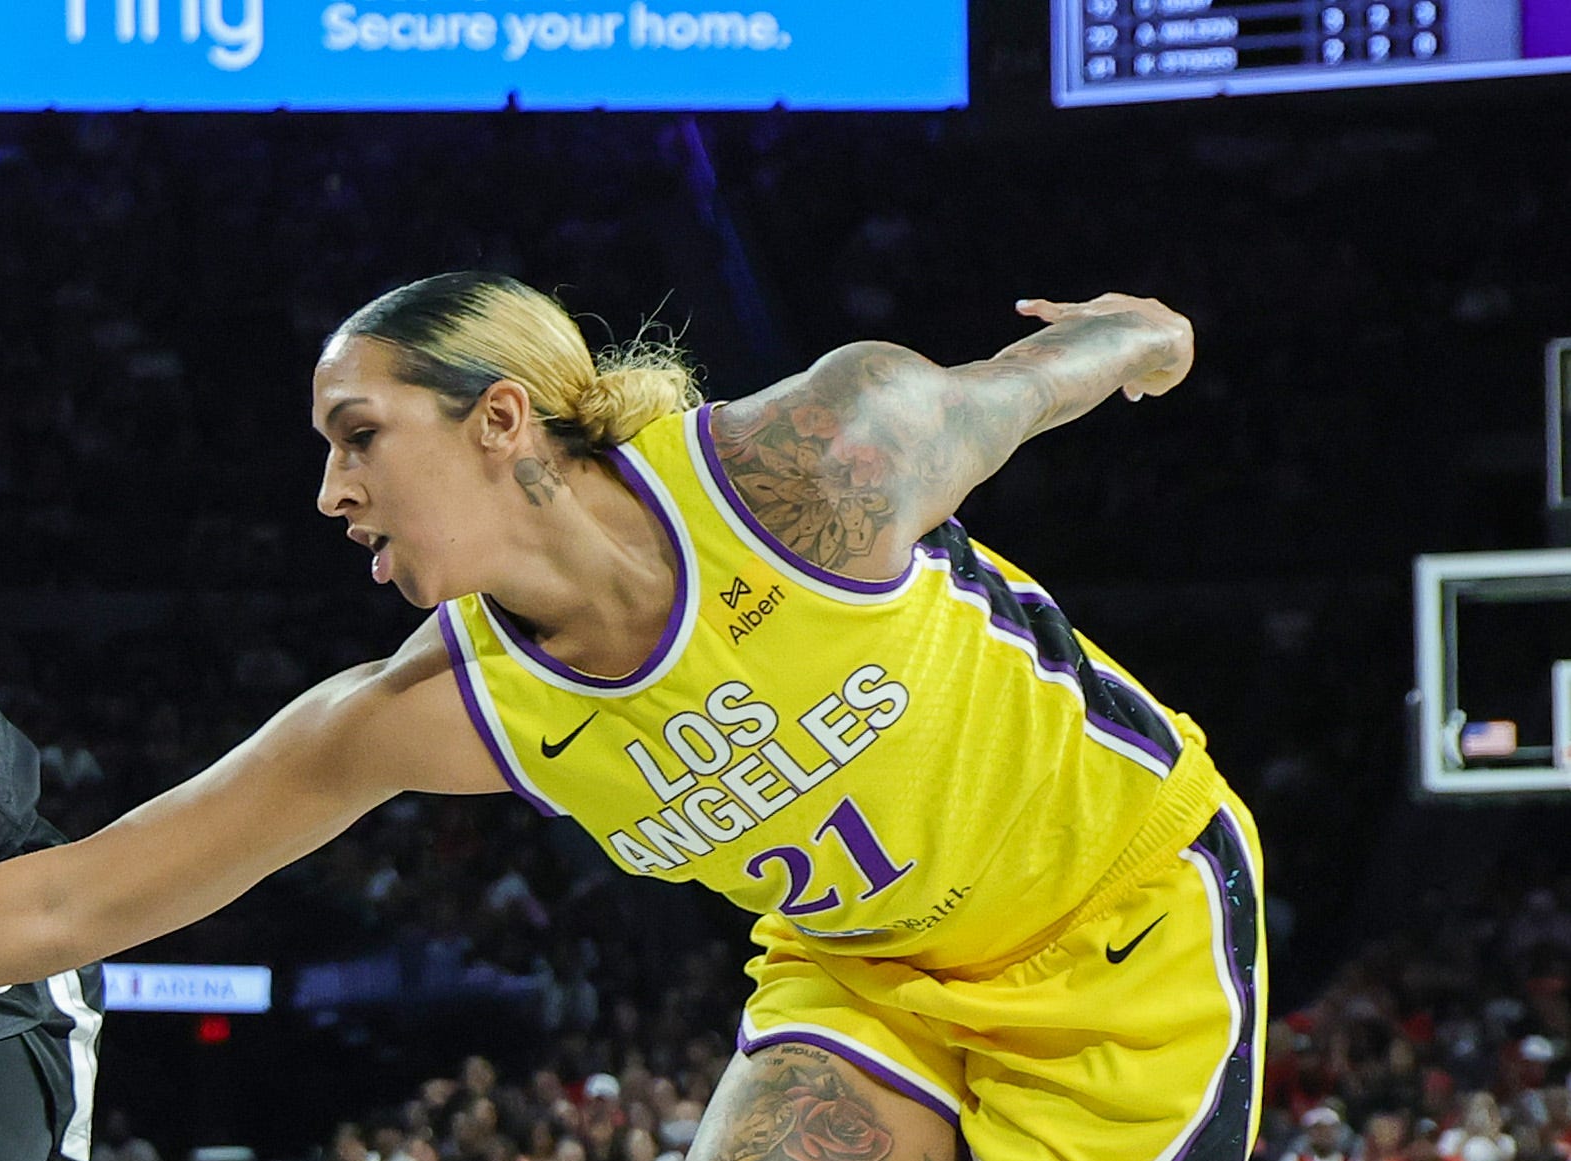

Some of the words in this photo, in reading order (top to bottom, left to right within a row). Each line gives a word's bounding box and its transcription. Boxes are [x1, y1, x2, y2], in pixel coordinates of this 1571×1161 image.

[321, 3, 498, 51] Secure
[503, 12, 624, 61] your
[629, 3, 792, 50] home.
[728, 584, 786, 644] Albert
[607, 664, 910, 874] ANGELES
[625, 680, 779, 804] LOS
[744, 795, 917, 918] 21
